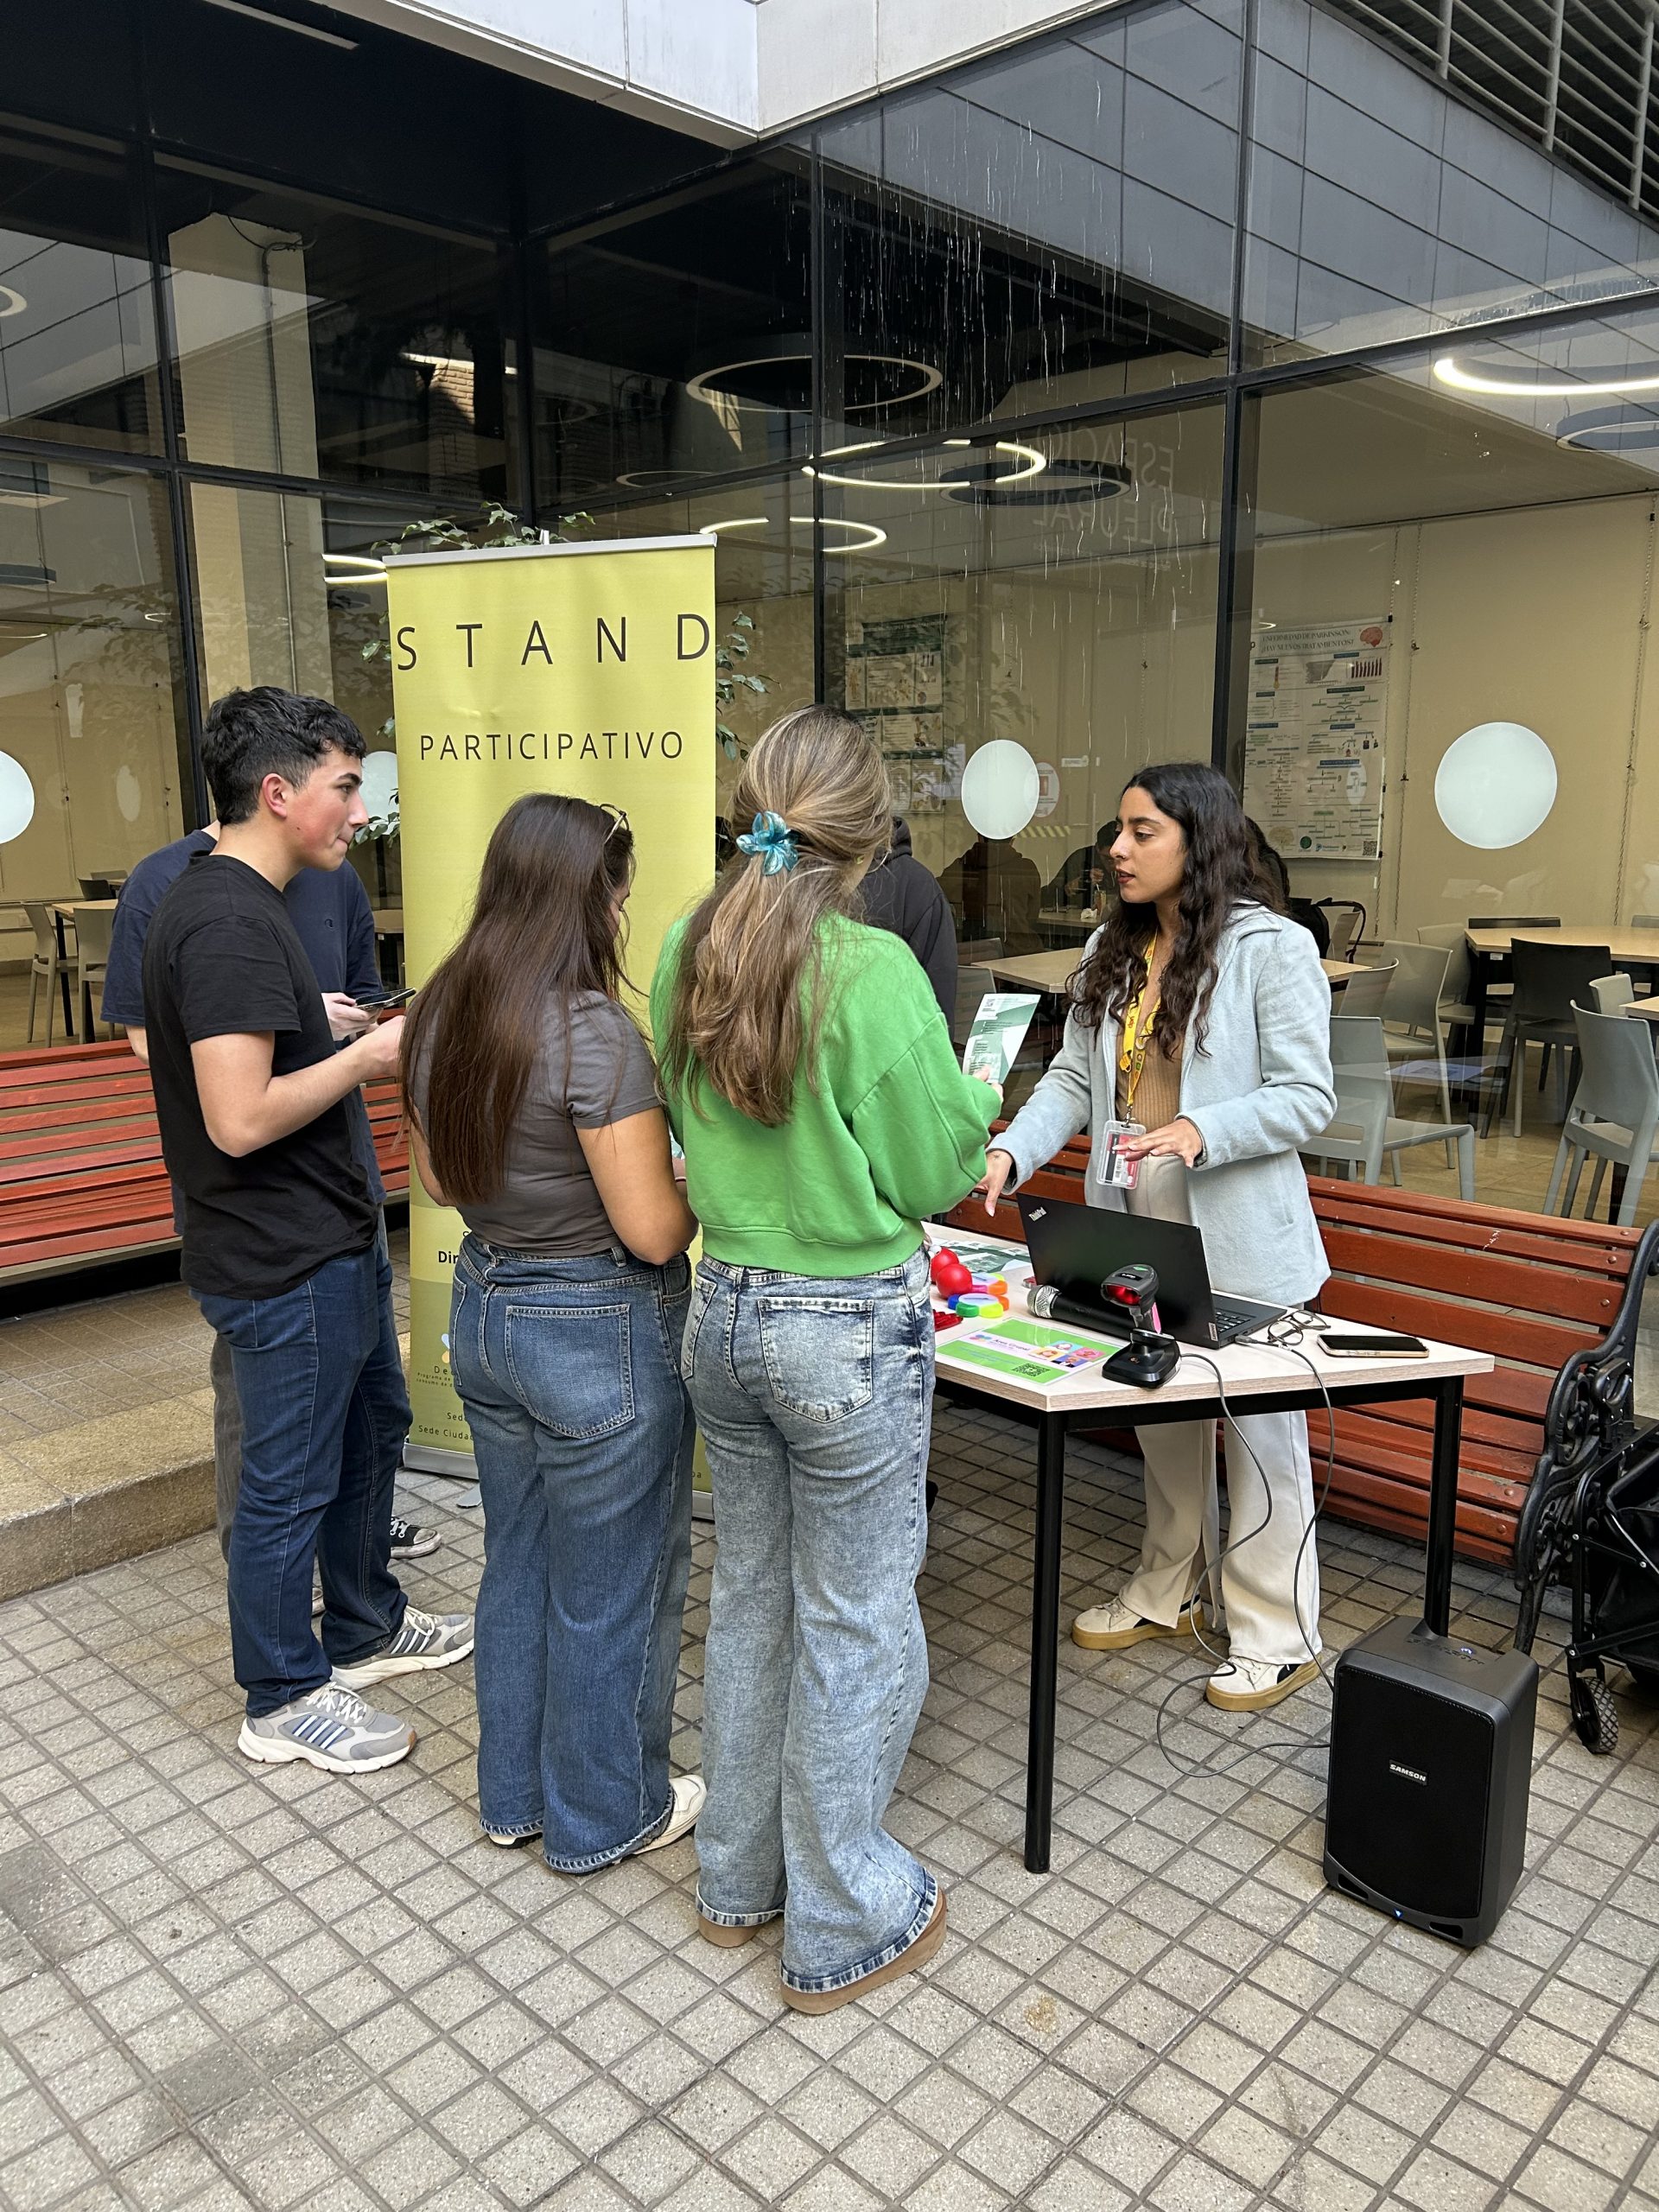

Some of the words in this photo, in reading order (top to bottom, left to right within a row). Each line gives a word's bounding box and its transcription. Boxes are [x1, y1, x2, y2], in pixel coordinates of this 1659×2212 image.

[396, 613, 711, 671] STAND
[420, 730, 683, 761] PARTICIPATIVO
[417, 1372, 442, 1381] Programa
[447, 1412, 464, 1421] Sed
[418, 1425, 440, 1435] Sede
[1389, 1764, 1427, 1782] SAMSON
